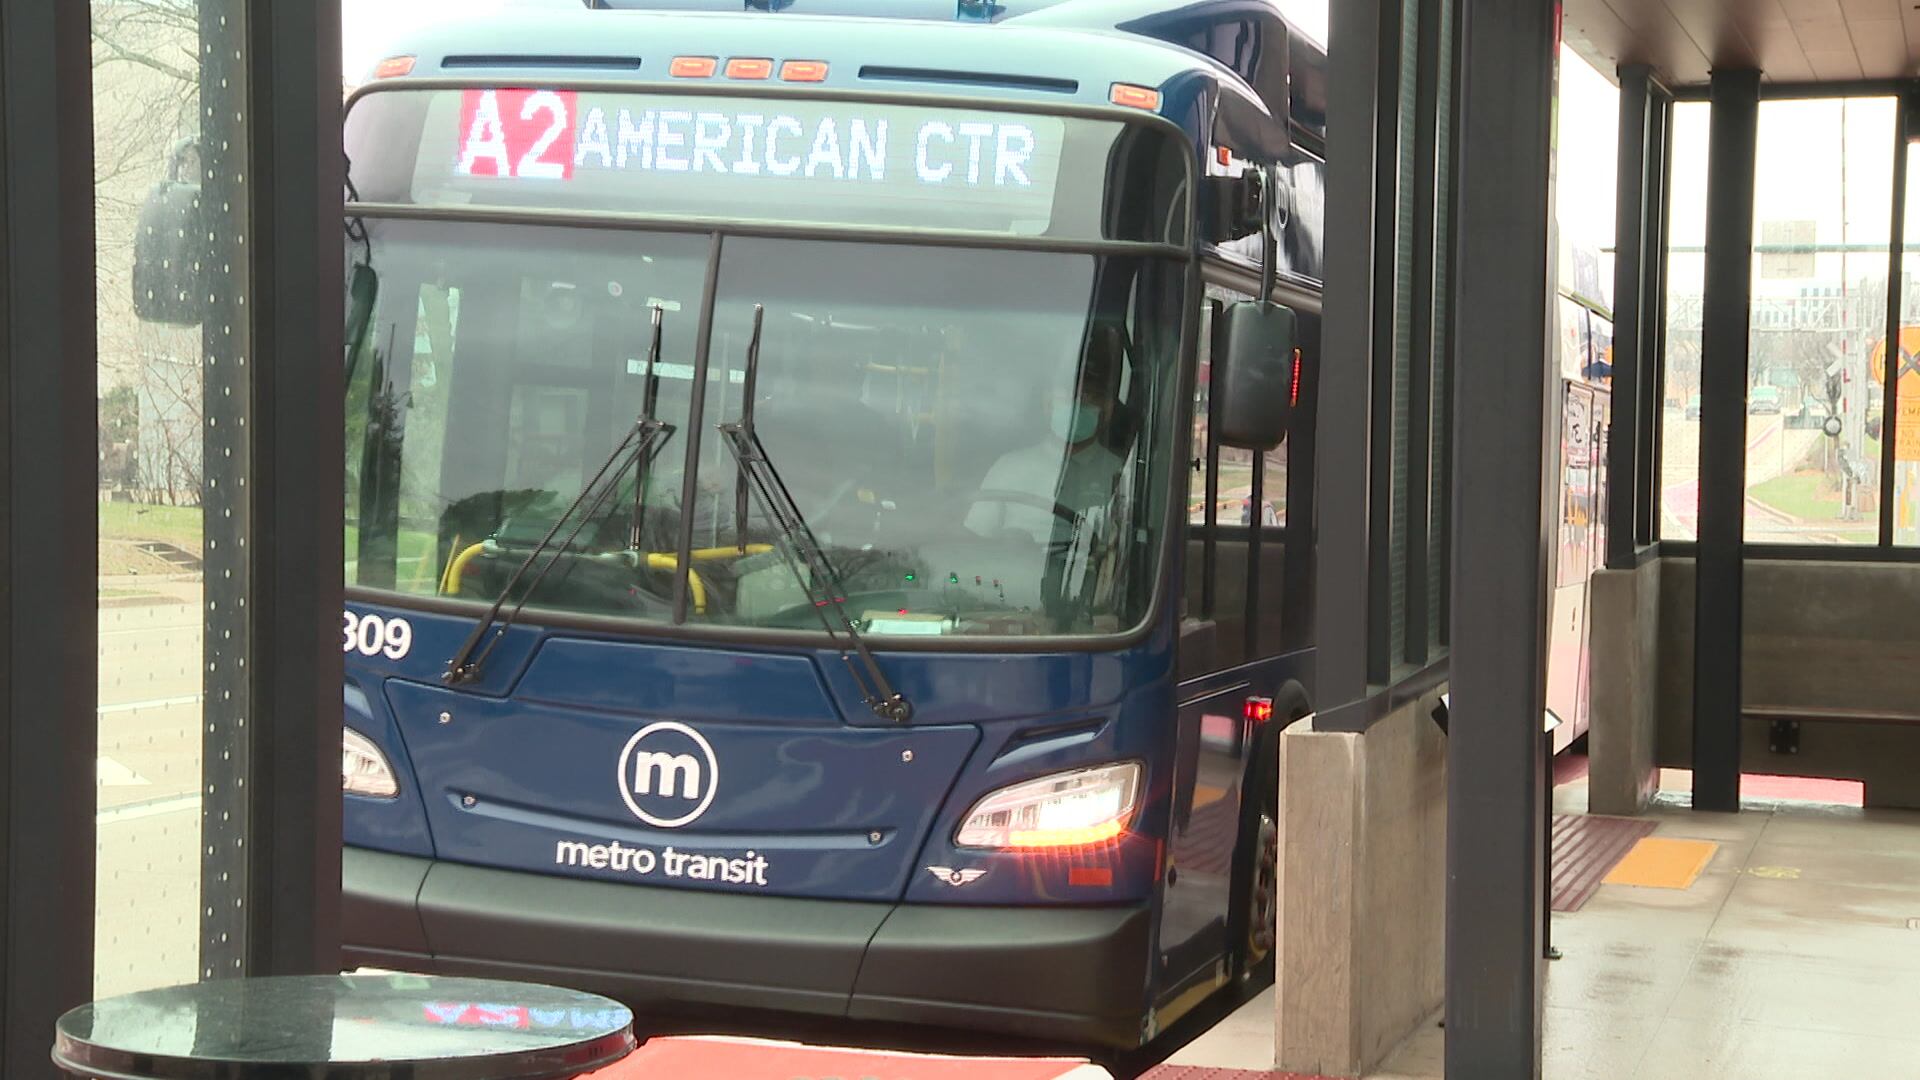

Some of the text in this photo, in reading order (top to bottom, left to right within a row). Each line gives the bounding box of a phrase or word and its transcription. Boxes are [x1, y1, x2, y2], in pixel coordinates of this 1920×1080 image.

[455, 89, 1035, 186] A2 AMERICAN CTR
[634, 750, 701, 799] m
[556, 840, 769, 886] metro transit
